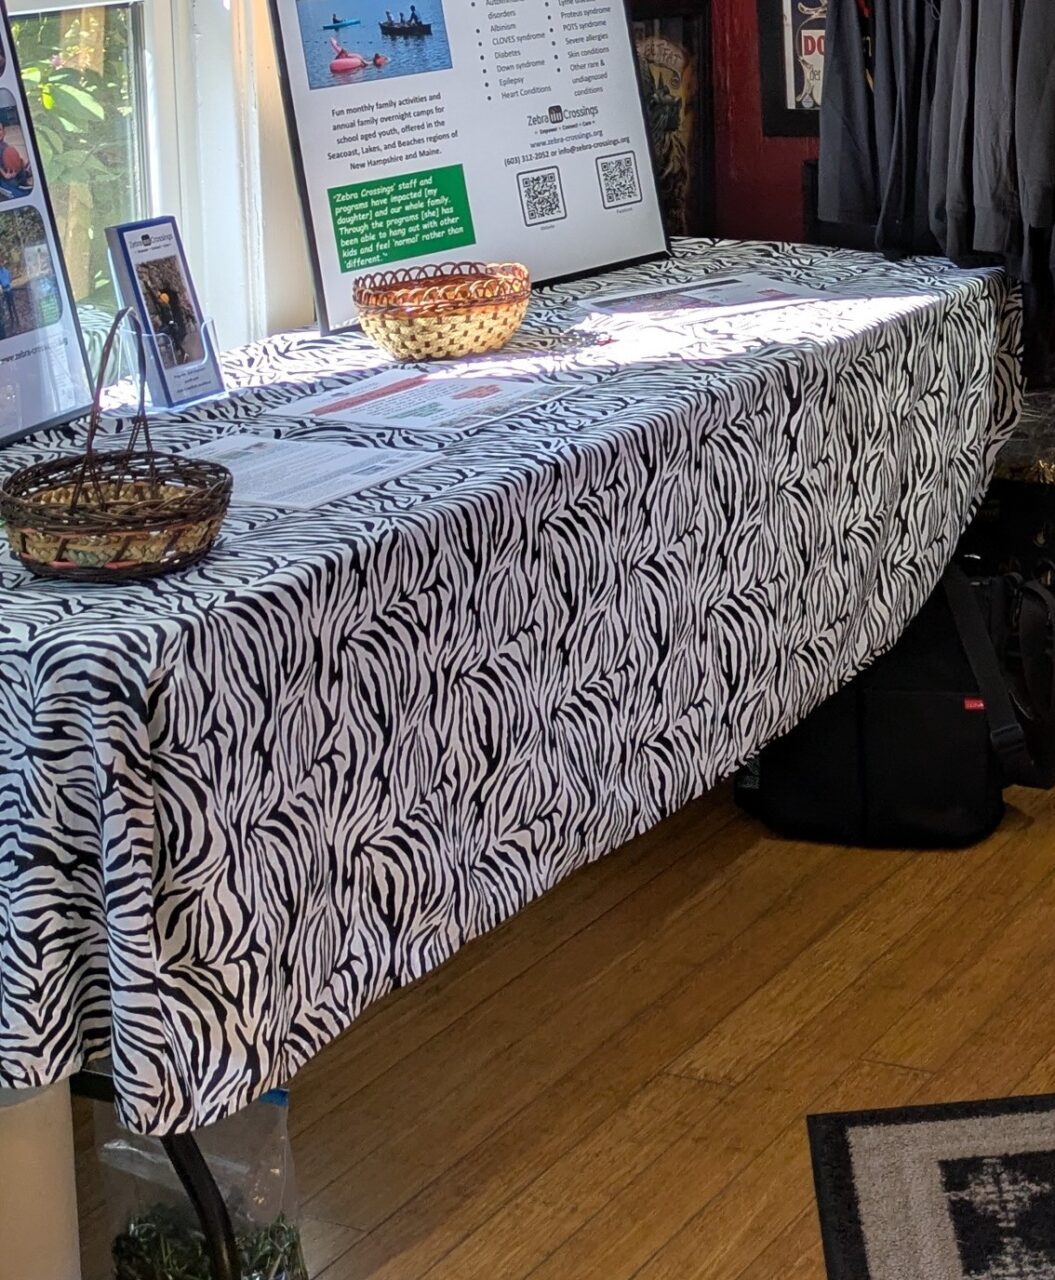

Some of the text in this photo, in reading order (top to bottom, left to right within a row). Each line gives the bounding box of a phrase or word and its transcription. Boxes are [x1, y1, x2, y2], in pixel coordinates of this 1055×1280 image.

[331, 92, 441, 117] Fun monthly family activities and
[527, 105, 599, 126] Zebra Crossings
[332, 105, 444, 131] annual family overnight camps for
[336, 134, 359, 144] school
[360, 131, 376, 141] aged
[401, 124, 425, 134] offered
[426, 121, 433, 129] in
[384, 141, 396, 151] and
[397, 138, 425, 148] Beaches
[426, 133, 450, 143] regions
[450, 130, 459, 138] of
[530, 129, 603, 148] www.zebra-crossings.org
[350, 162, 366, 170] New
[367, 155, 403, 167] Hampshire
[405, 152, 417, 160] and
[504, 156, 521, 167] (603)
[522, 151, 549, 161] 312-2052
[558, 136, 630, 155] info@zebra-crossings.org
